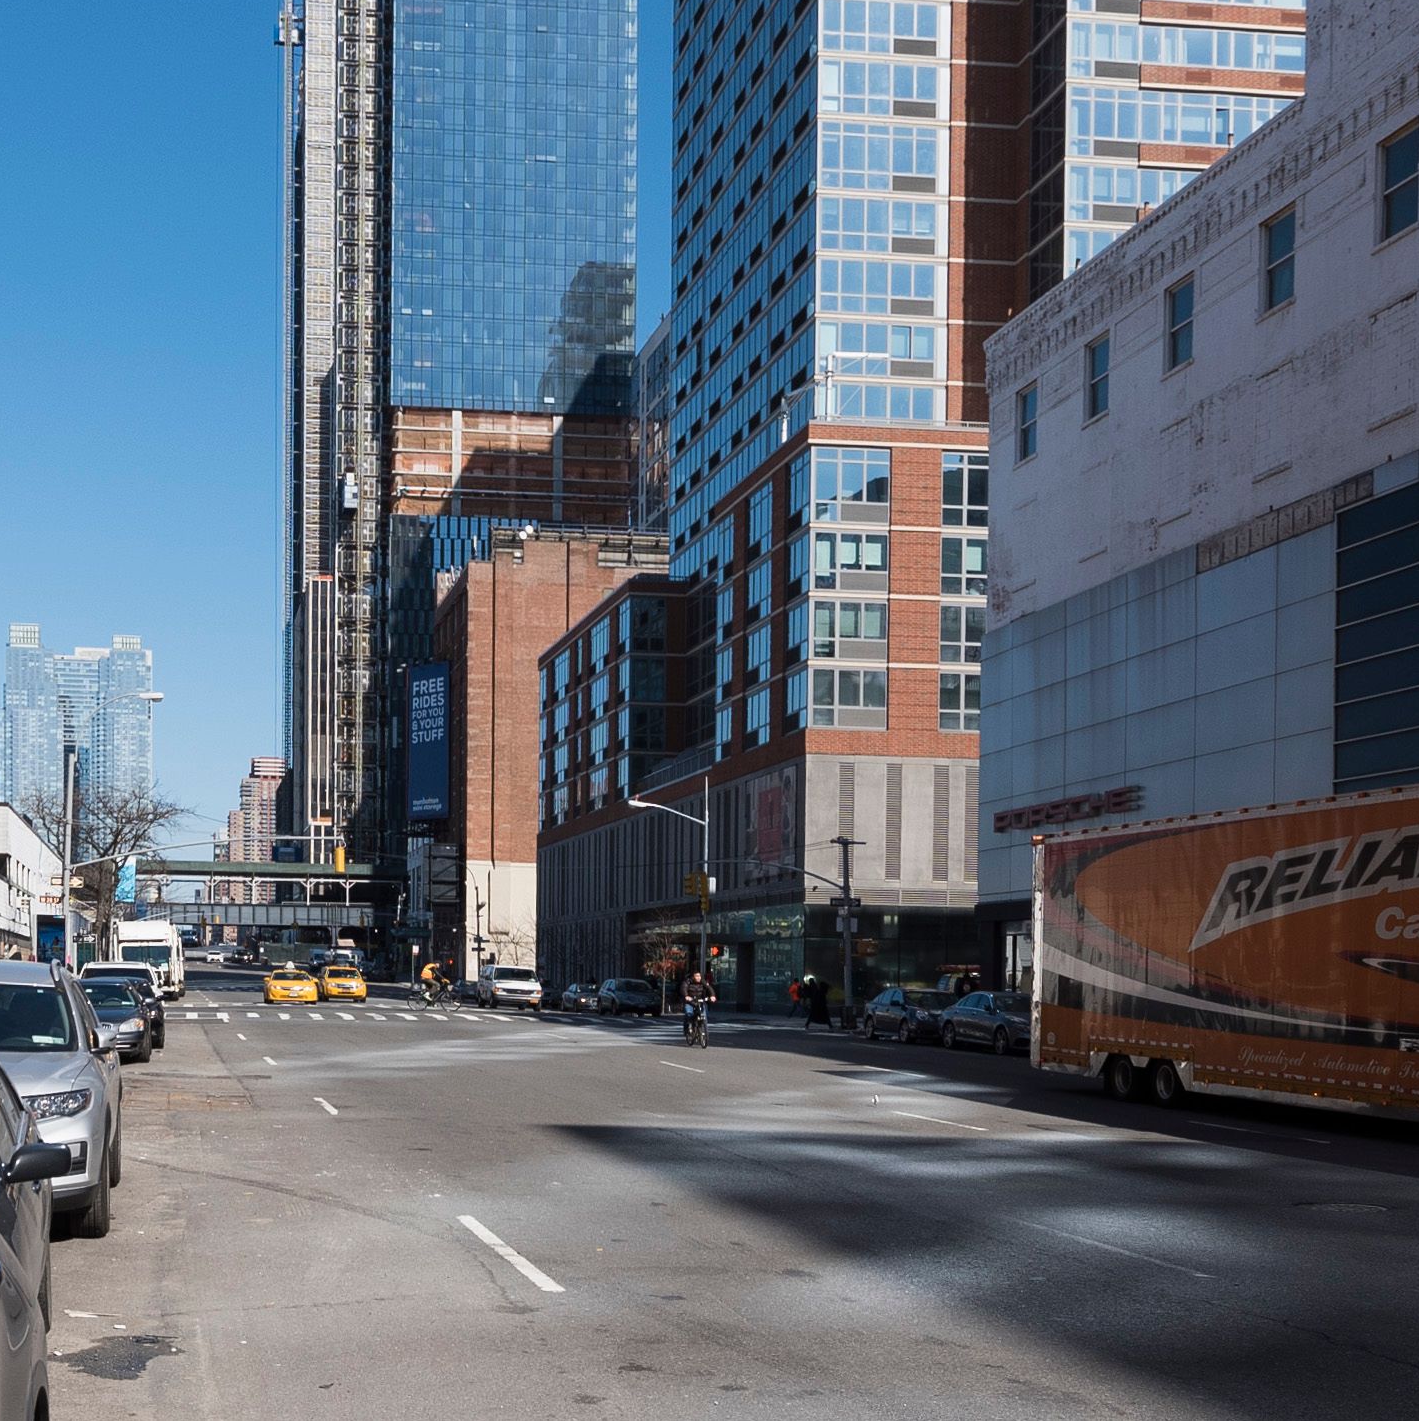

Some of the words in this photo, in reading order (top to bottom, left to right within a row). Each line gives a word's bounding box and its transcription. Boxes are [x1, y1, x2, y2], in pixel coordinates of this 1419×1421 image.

[413, 677, 444, 696] FREE
[412, 693, 444, 710] RIDES
[412, 709, 427, 720] FOR
[428, 707, 444, 718] YOU
[420, 717, 444, 729] YOUR
[412, 729, 444, 744] STUFF
[994, 785, 1145, 833] PORSCHE
[1237, 1045, 1306, 1072] Specialized
[1313, 1055, 1392, 1076] Automotive
